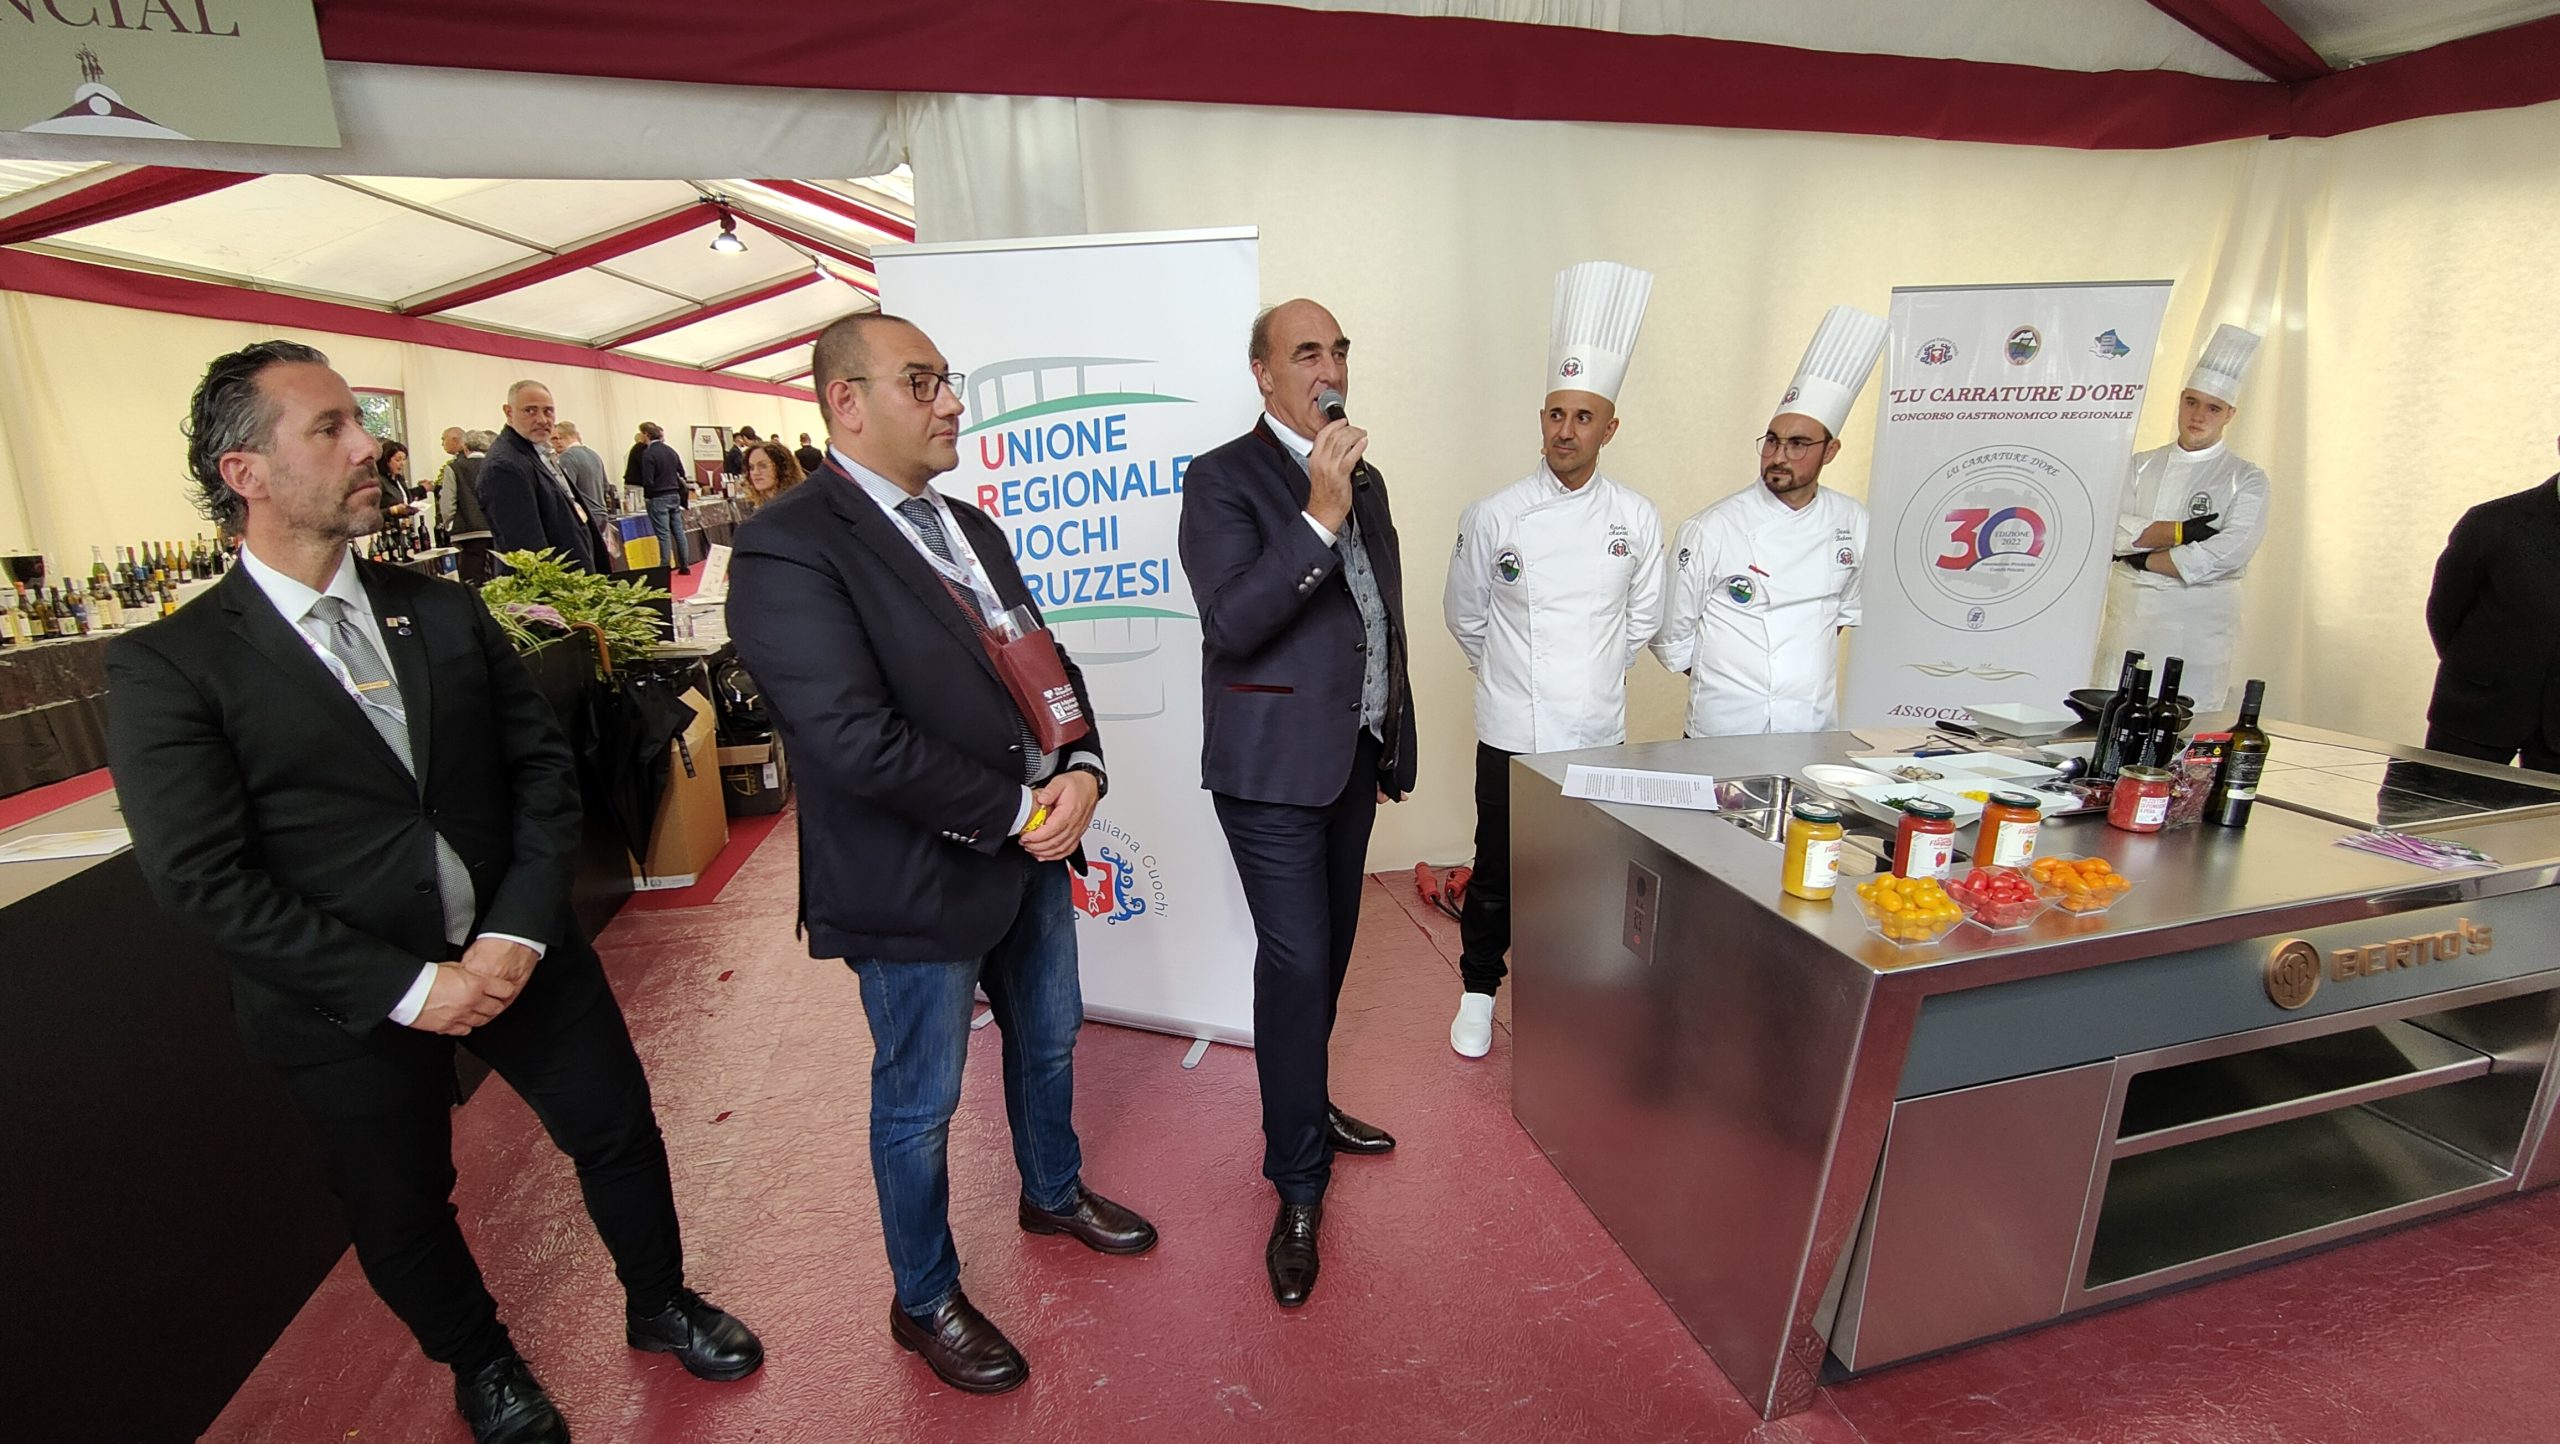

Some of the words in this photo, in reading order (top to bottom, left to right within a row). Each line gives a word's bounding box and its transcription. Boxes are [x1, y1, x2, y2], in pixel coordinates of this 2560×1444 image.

[1891, 411, 1953, 422] CONCORSO
[1956, 411, 2058, 421] GASTRONOMICO
[2060, 411, 2134, 420] REGIONALE
[1930, 385, 2063, 402] CARRATURE
[980, 413, 1128, 471] UNIONE
[1962, 452, 2029, 469] CARRATURE
[977, 454, 1194, 518] REGIONALE
[1013, 515, 1119, 563] UOCHI
[2001, 538, 2021, 546] 2022
[1023, 558, 1170, 607] RUZZESI
[1089, 818, 1141, 854] aliana
[1142, 854, 1169, 918] Cuochi
